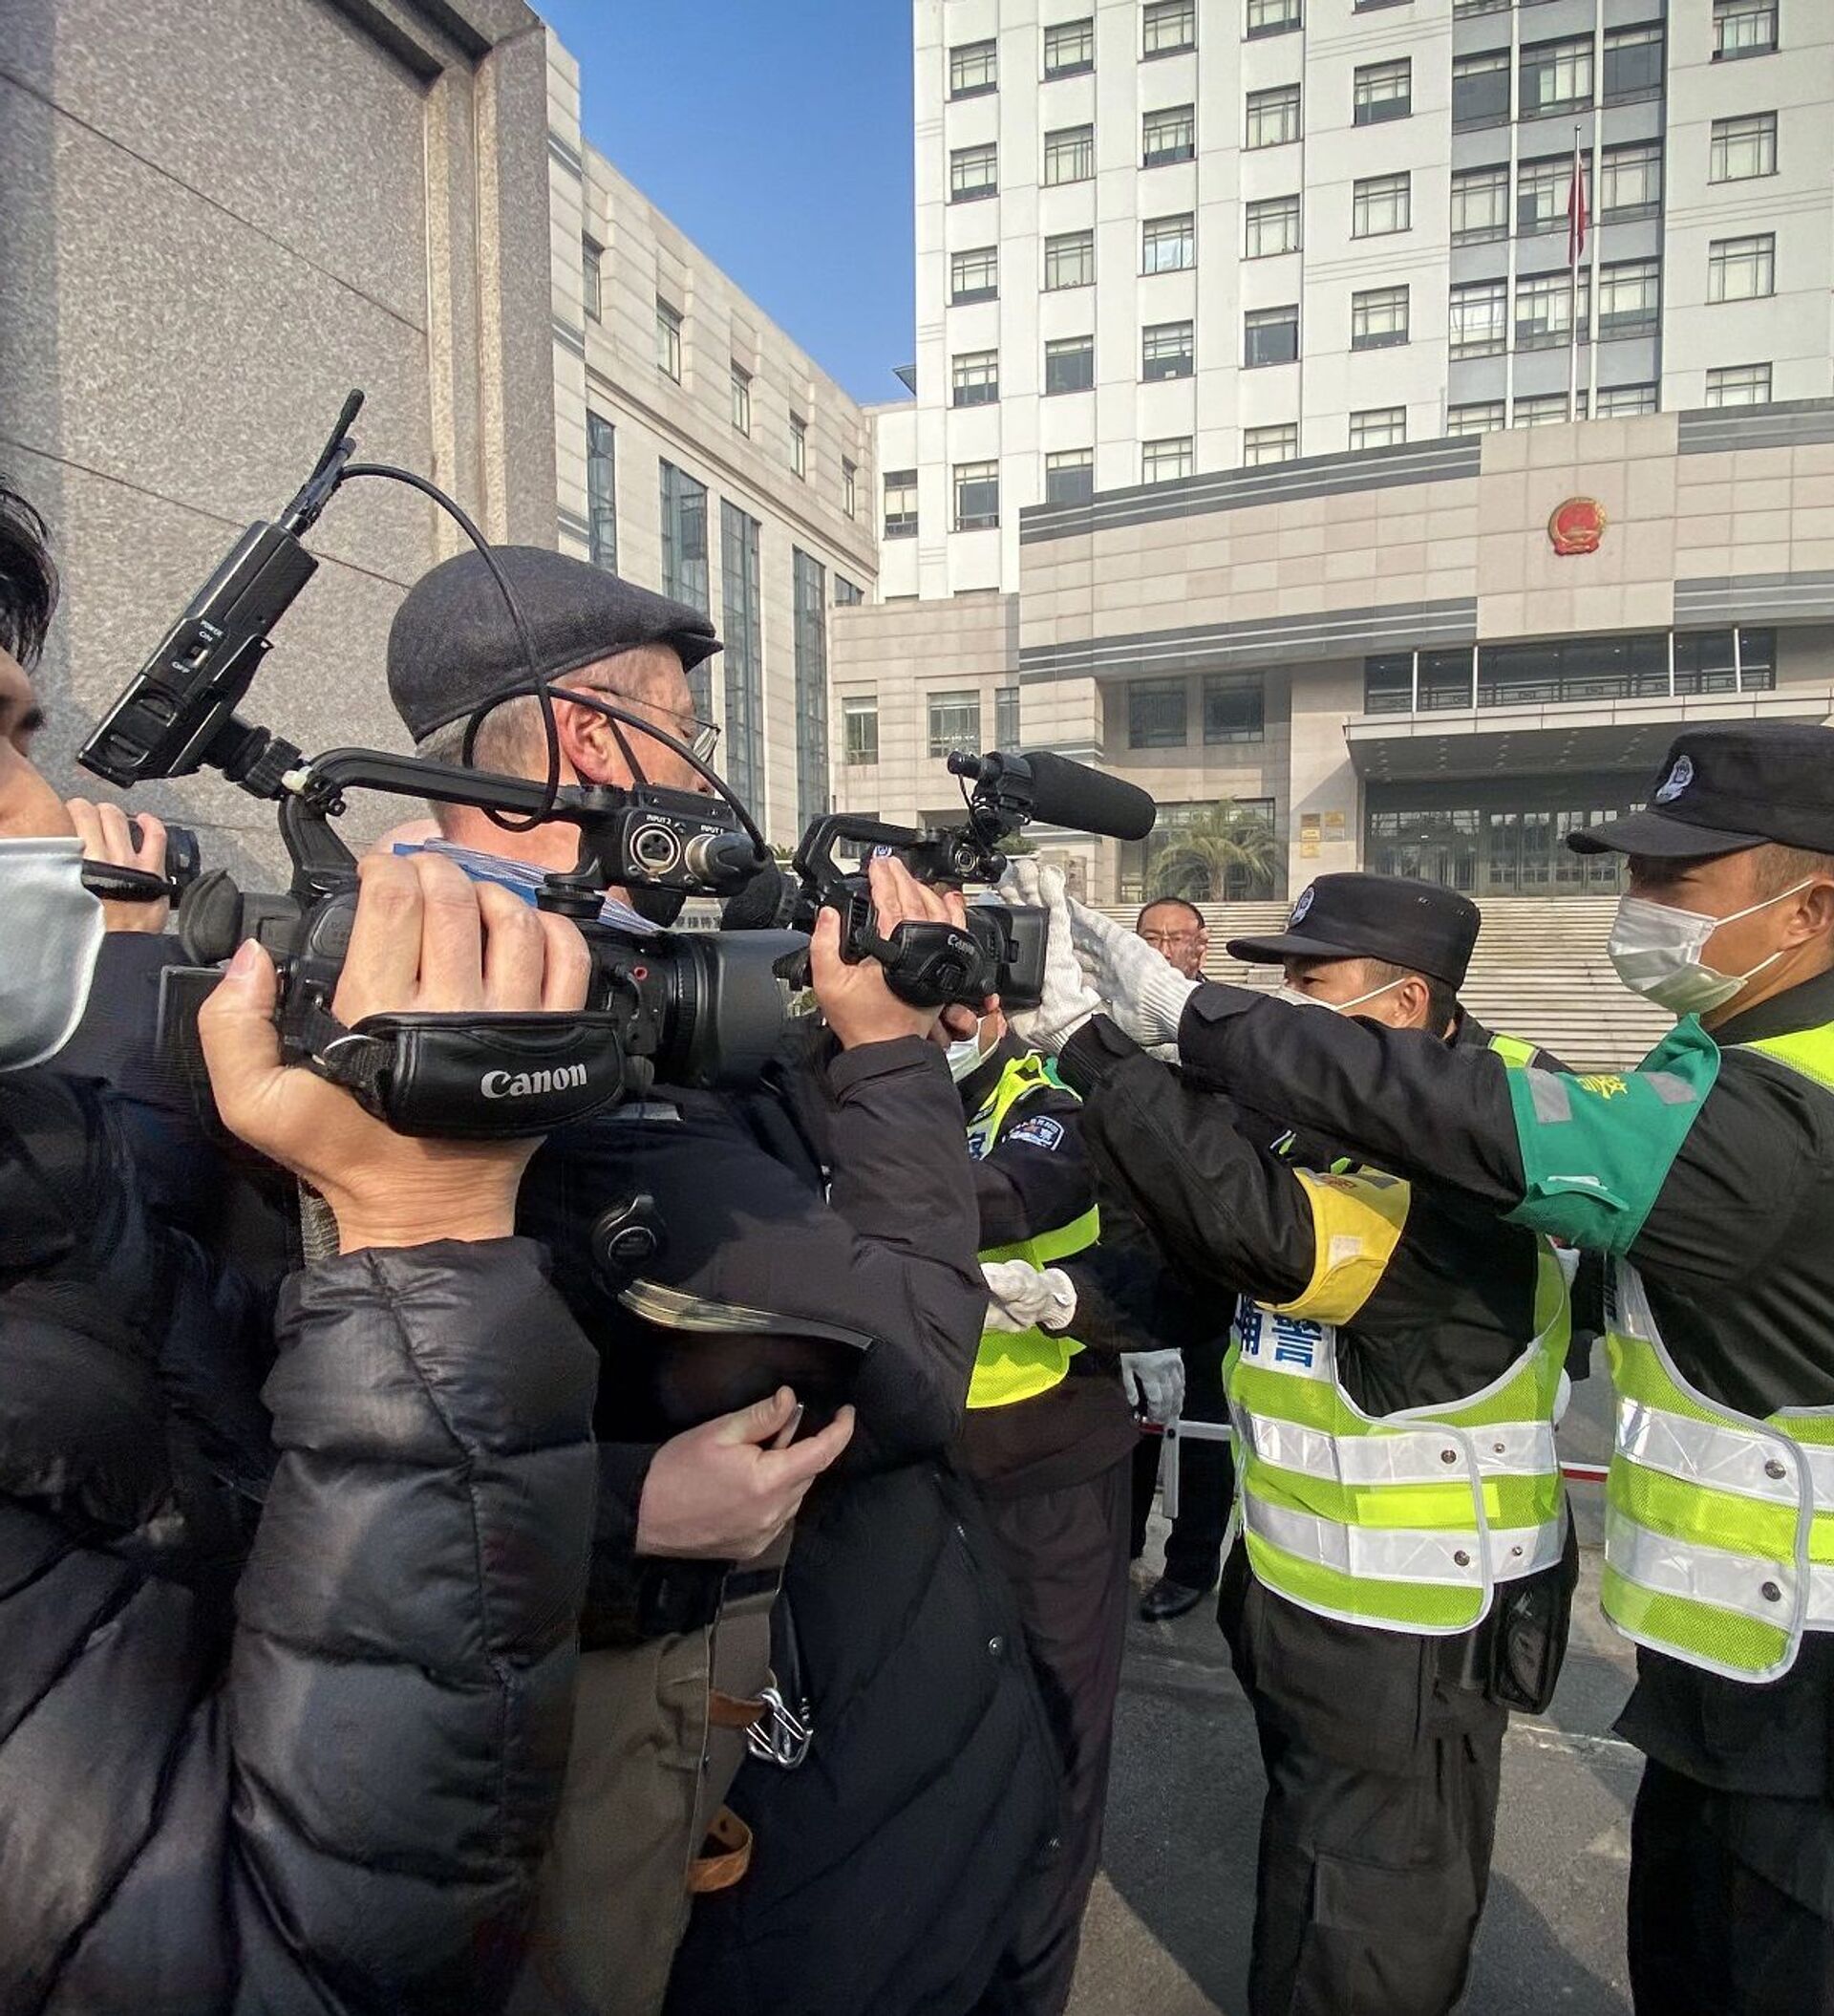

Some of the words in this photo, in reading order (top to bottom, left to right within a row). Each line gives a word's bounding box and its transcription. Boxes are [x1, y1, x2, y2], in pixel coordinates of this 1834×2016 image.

[199, 631, 213, 642] ON
[647, 814, 666, 824] INPUT
[700, 825, 719, 834] INPUT
[480, 1063, 587, 1099] Canon
